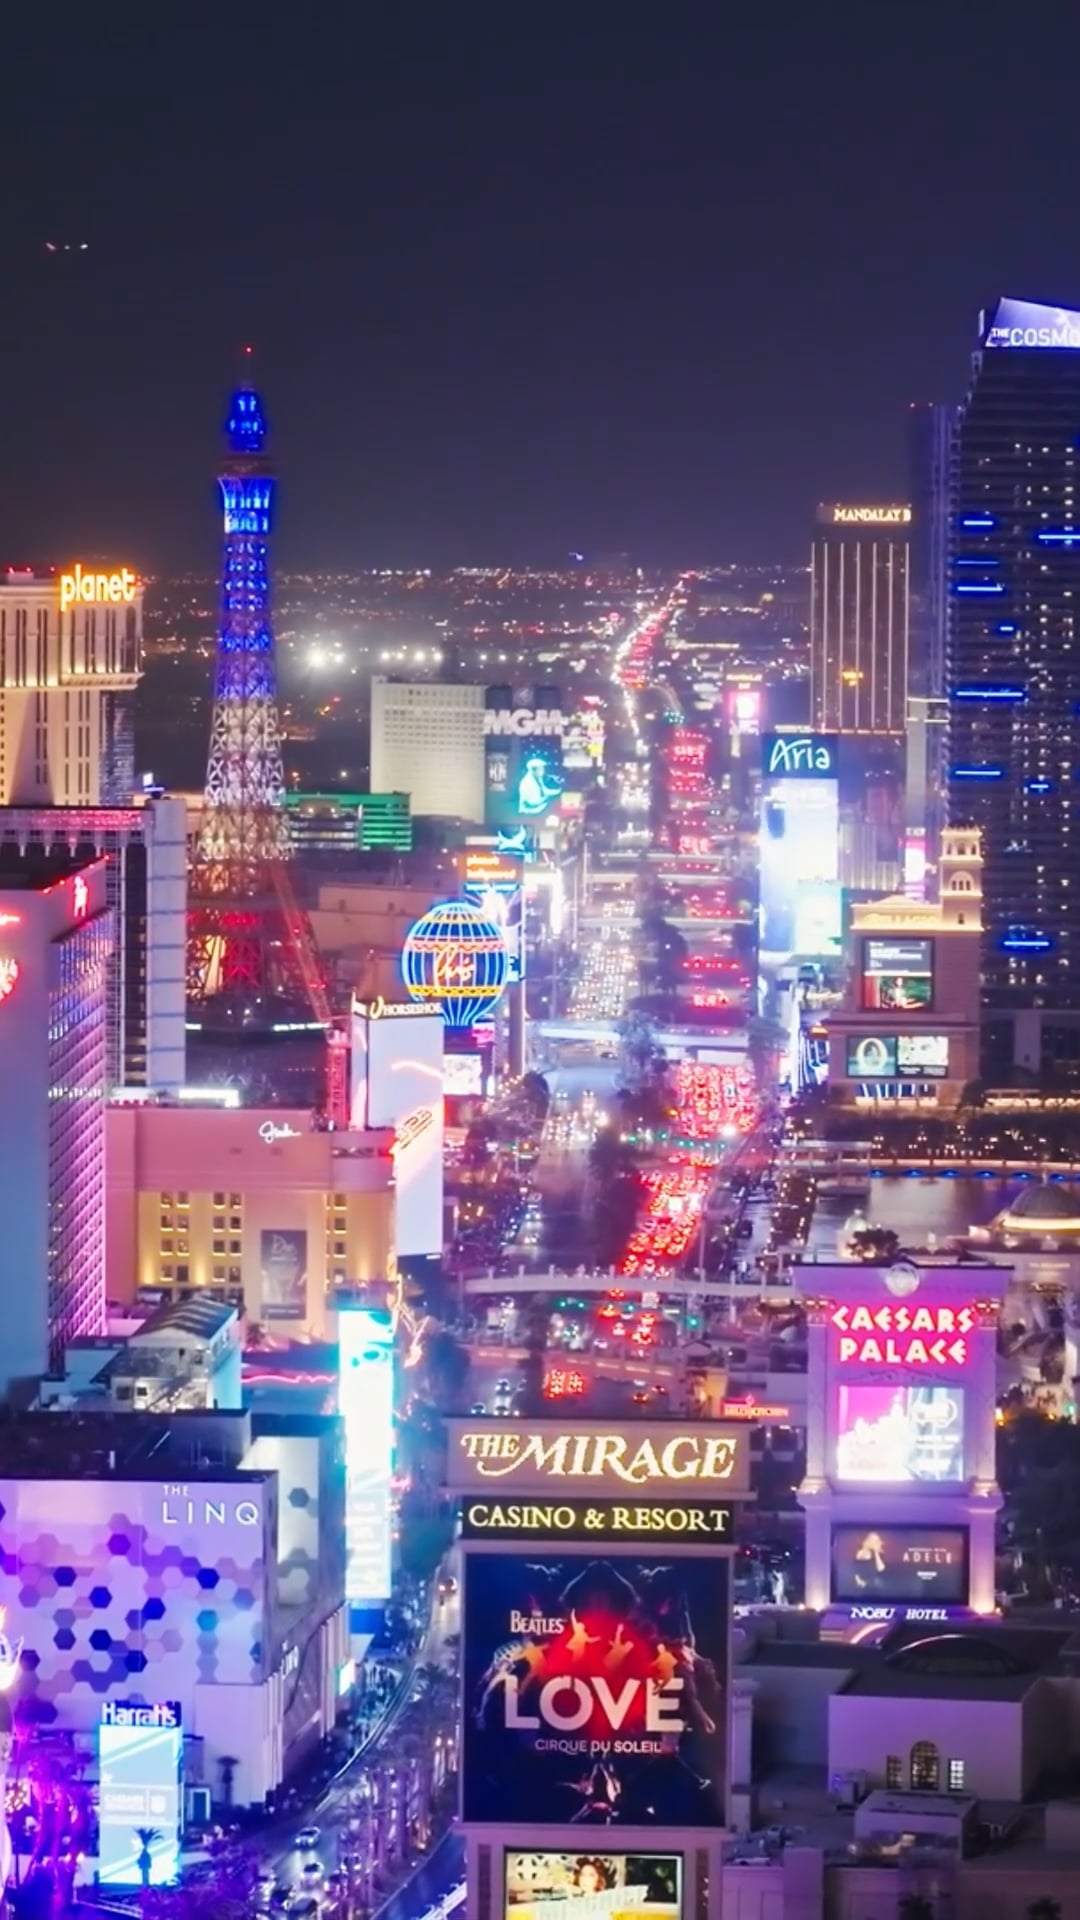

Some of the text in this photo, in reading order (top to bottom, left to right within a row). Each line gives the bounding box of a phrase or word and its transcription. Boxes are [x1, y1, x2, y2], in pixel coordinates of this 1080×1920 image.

[833, 508, 900, 522] MANDALAY
[60, 563, 135, 612] planet
[482, 708, 563, 736] MGM
[769, 739, 830, 772] Aria
[832, 1306, 975, 1334] CAESARS
[840, 1337, 967, 1365] PALACE
[460, 1434, 737, 1484] THE MIRAGE
[163, 1485, 189, 1496] THE
[163, 1501, 259, 1526] LINQ
[468, 1505, 729, 1532] CASINO & RESORT
[902, 1552, 952, 1564] ADELE
[511, 1610, 565, 1636] BEATLES
[850, 1607, 949, 1620] NOBU HOTEL
[503, 1675, 685, 1733] LOVE
[534, 1739, 587, 1755] CIRQUE
[590, 1740, 611, 1756] DU
